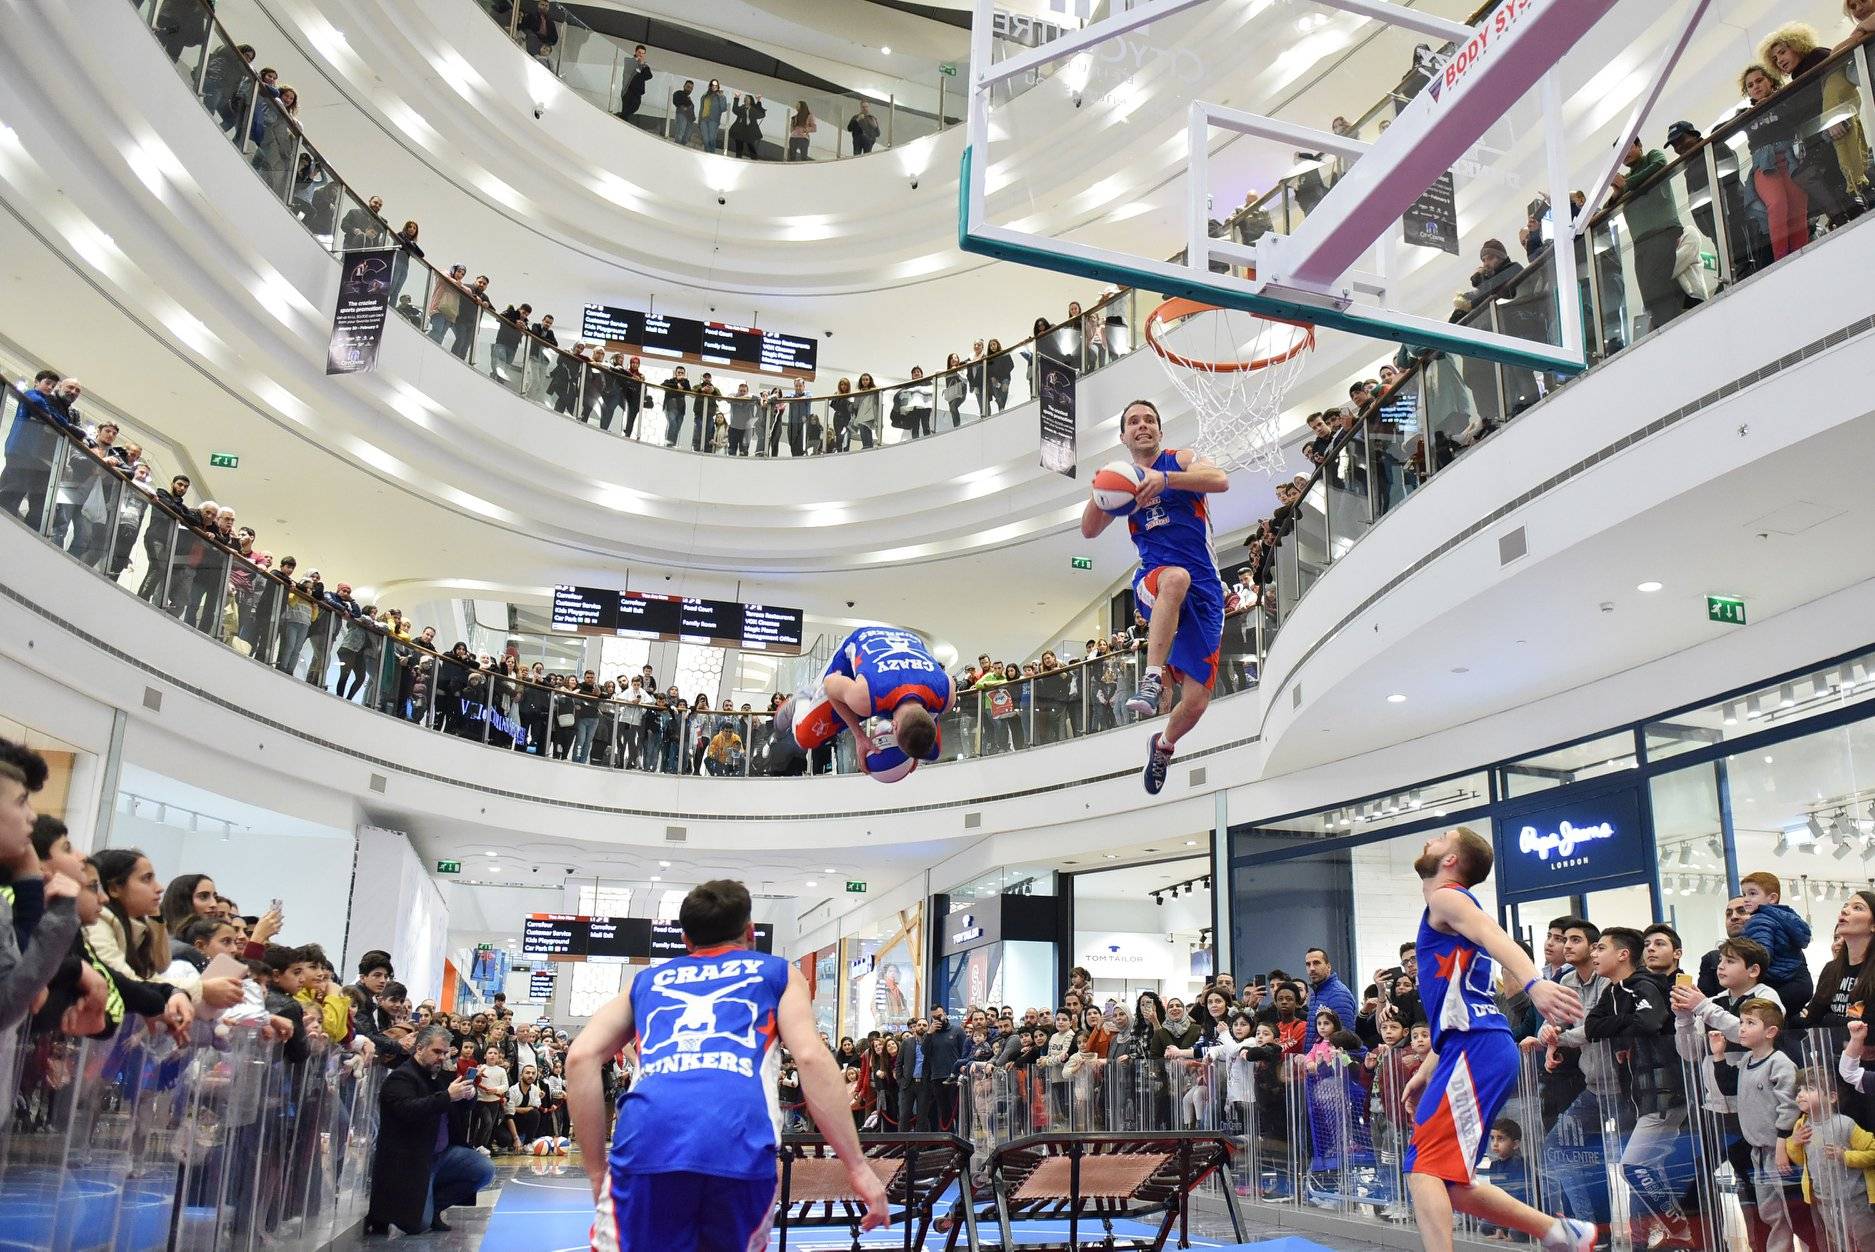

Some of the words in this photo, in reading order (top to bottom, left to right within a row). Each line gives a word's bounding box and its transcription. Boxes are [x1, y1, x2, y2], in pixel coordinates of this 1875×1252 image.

[1446, 23, 1490, 88] BODY
[585, 309, 611, 319] Carrefour
[584, 316, 610, 325] Customer
[609, 320, 628, 329] Service
[645, 319, 671, 328] Carrefour
[596, 325, 627, 335] Playground
[645, 325, 657, 333] Mall
[657, 327, 668, 335] Exit
[704, 328, 719, 336] Food
[718, 330, 733, 338] Court
[703, 341, 721, 350] Family
[720, 344, 737, 352] Room
[556, 591, 583, 600] Carrefour
[555, 599, 582, 608] Customer
[581, 601, 602, 610] Service
[620, 598, 647, 607] Carrefour
[554, 607, 567, 615] Kids
[567, 608, 600, 618] Playground
[619, 605, 633, 613] Mall
[683, 604, 698, 612] Food
[697, 606, 713, 614] Court
[553, 614, 564, 622] Car
[564, 615, 578, 623] Park
[745, 610, 765, 618] Terrace
[764, 612, 796, 622] Restaurants
[682, 619, 701, 628] Family
[700, 621, 717, 629] Room
[757, 619, 780, 628] Cinemas
[744, 625, 761, 634] Magic
[760, 626, 778, 635] Planet
[743, 632, 779, 642] Management
[877, 658, 935, 673] CRAZY
[1551, 857, 1589, 870] LONDON
[526, 920, 554, 928] Carrefour
[590, 923, 617, 931] Carrefour
[525, 928, 553, 936] Customer
[552, 929, 572, 937] Service
[667, 926, 683, 934] Court
[537, 937, 570, 946] Playground
[652, 941, 671, 950] Family
[524, 944, 535, 952] Car
[653, 959, 764, 987] CRAZY
